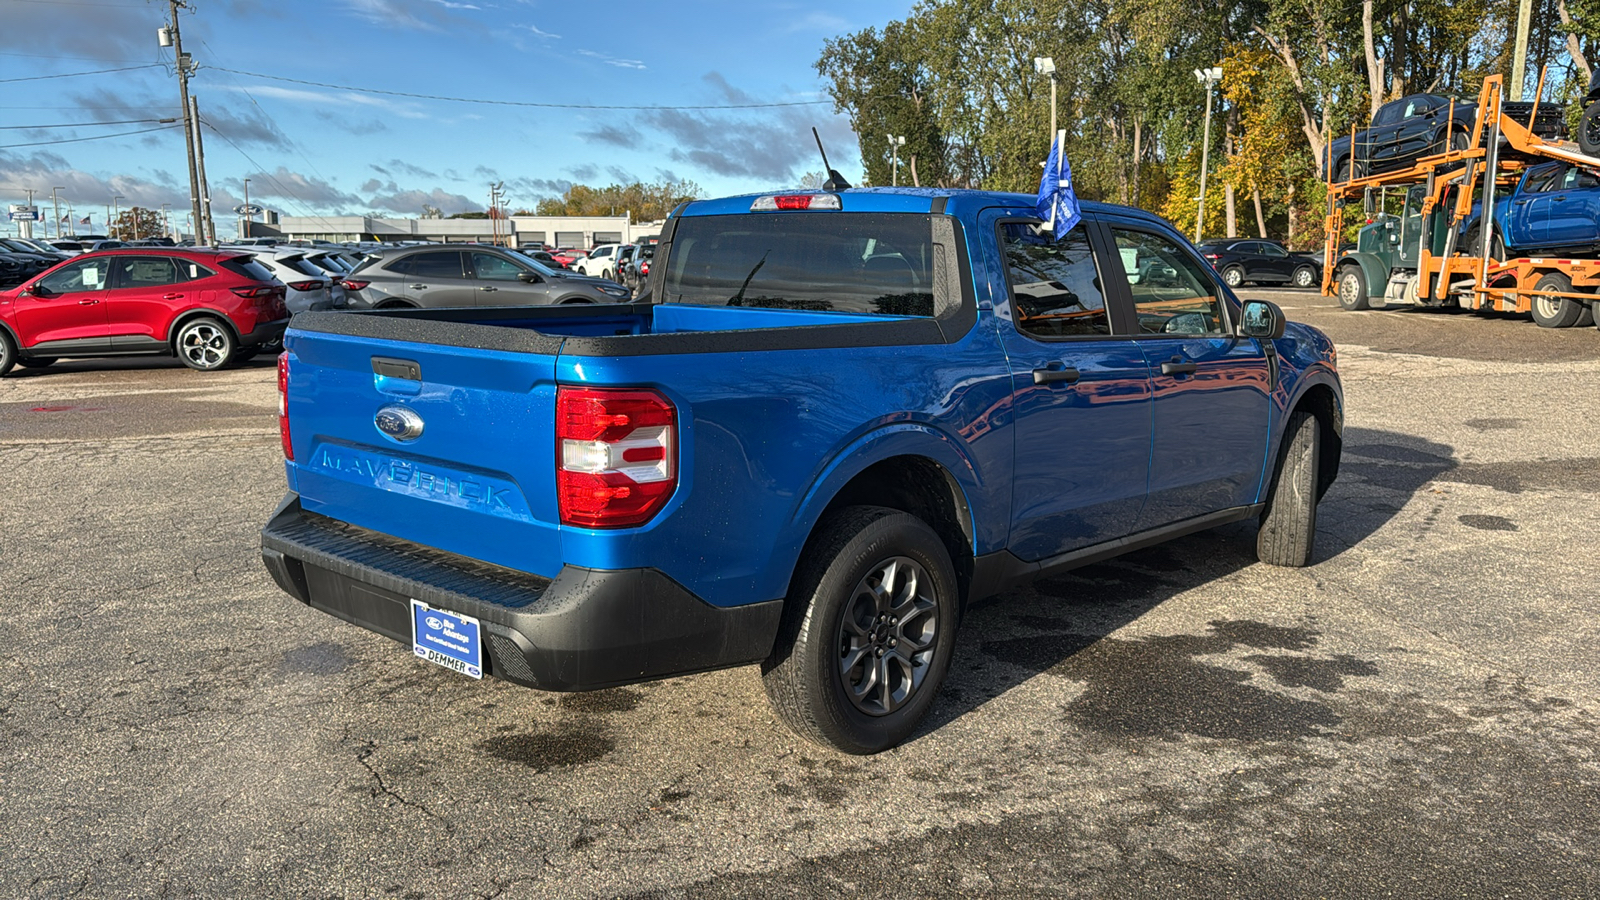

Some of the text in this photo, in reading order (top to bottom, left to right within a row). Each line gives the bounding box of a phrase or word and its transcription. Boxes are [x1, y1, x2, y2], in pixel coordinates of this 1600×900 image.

[240, 206, 258, 214] Ford
[322, 450, 511, 508] MAVERICK
[428, 650, 466, 672] DEMMER
